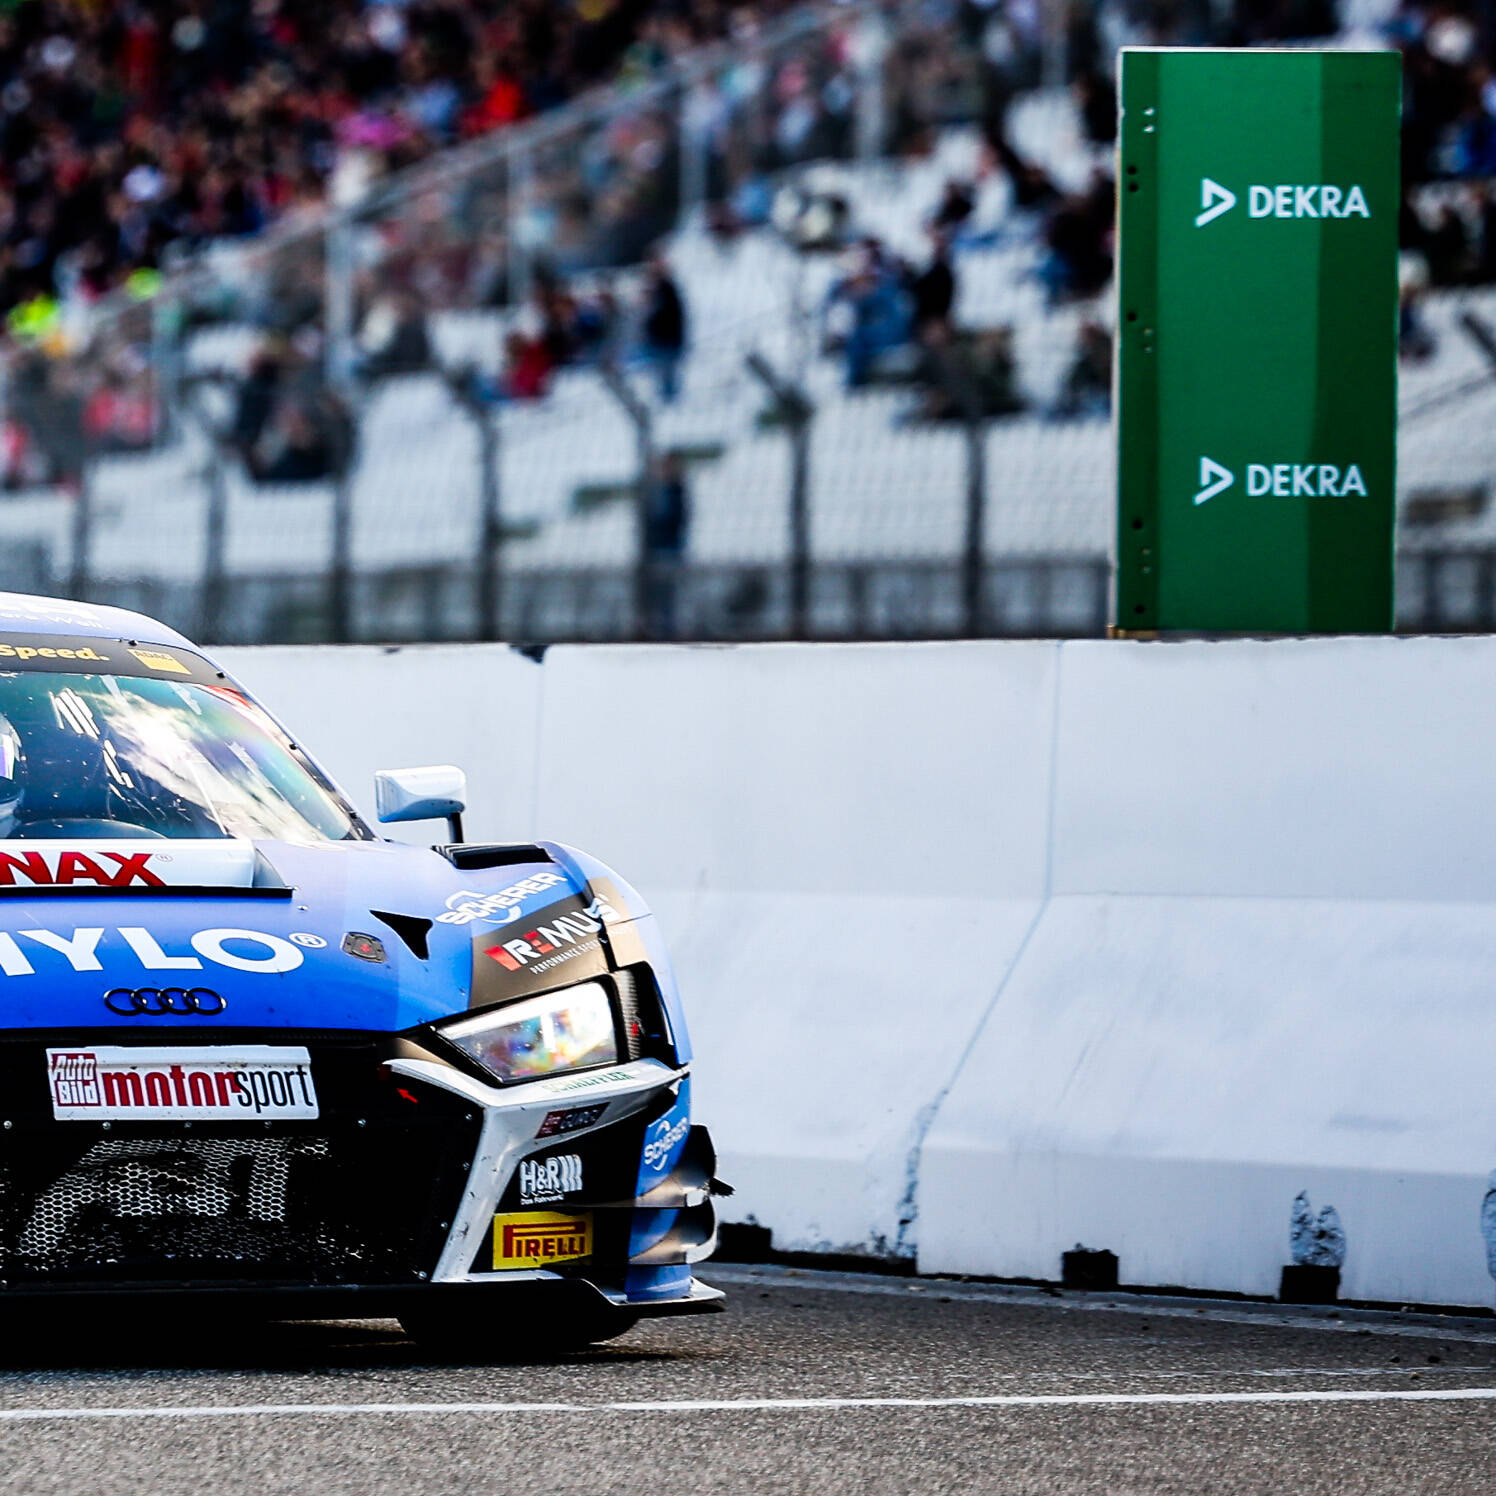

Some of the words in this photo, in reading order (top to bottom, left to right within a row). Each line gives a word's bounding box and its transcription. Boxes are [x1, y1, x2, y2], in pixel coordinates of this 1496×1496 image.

[1248, 185, 1371, 219] DEKRA
[1246, 464, 1368, 497] DEKRA
[435, 872, 569, 925] SCHERER
[501, 896, 622, 967] REMUS
[51, 1055, 96, 1081] Auto
[57, 1081, 99, 1104] Bild
[101, 1065, 314, 1114] motorsport
[520, 1157, 563, 1197] H&R
[502, 1221, 587, 1259] PIRELLI
